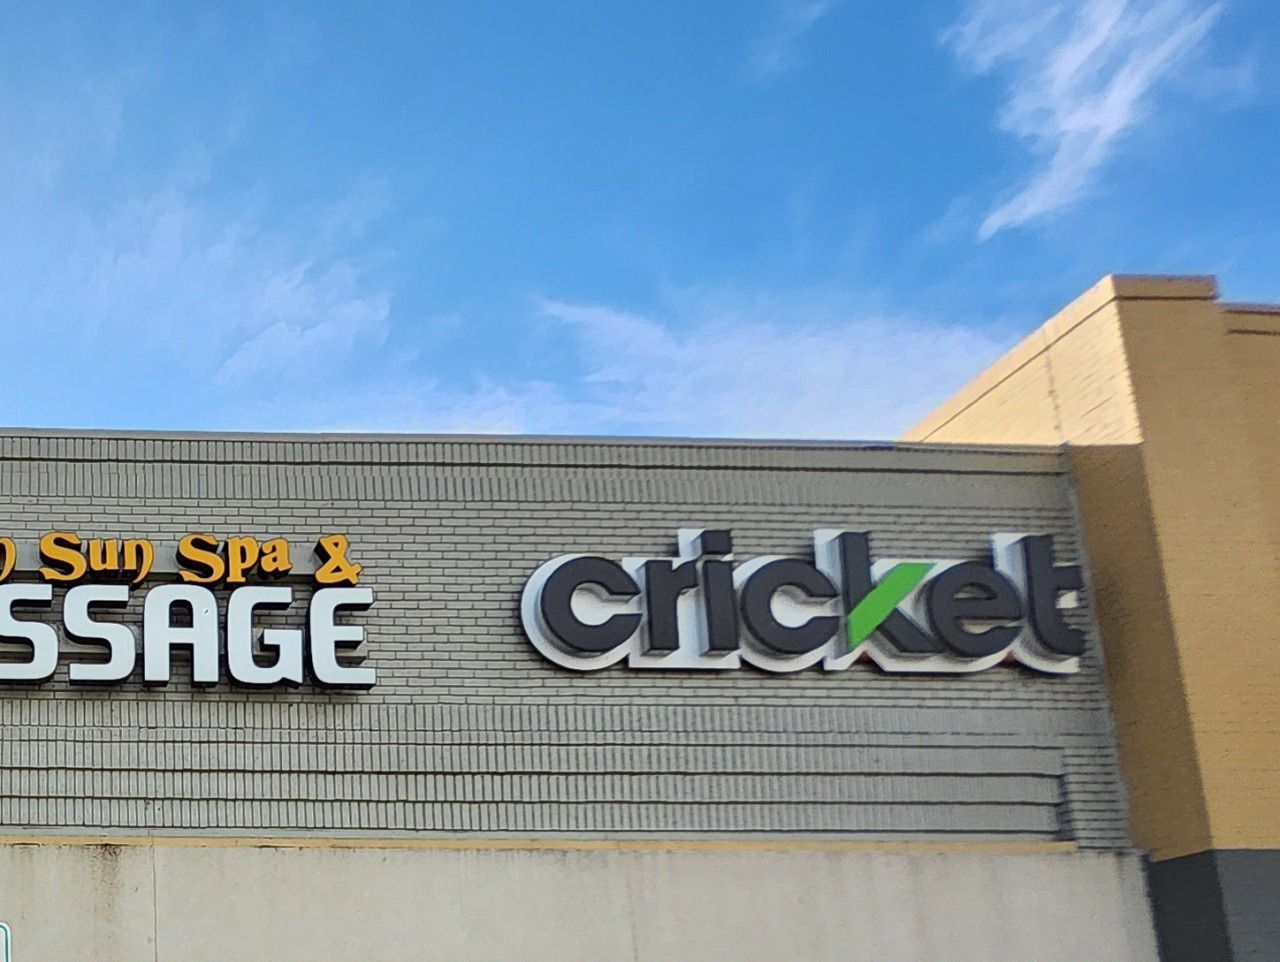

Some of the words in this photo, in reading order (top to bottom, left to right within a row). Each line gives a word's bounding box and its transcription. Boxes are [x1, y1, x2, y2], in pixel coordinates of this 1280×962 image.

[37, 531, 155, 587] Sun
[175, 532, 293, 584] Spa
[315, 532, 362, 586] &
[524, 528, 1087, 673] cricket
